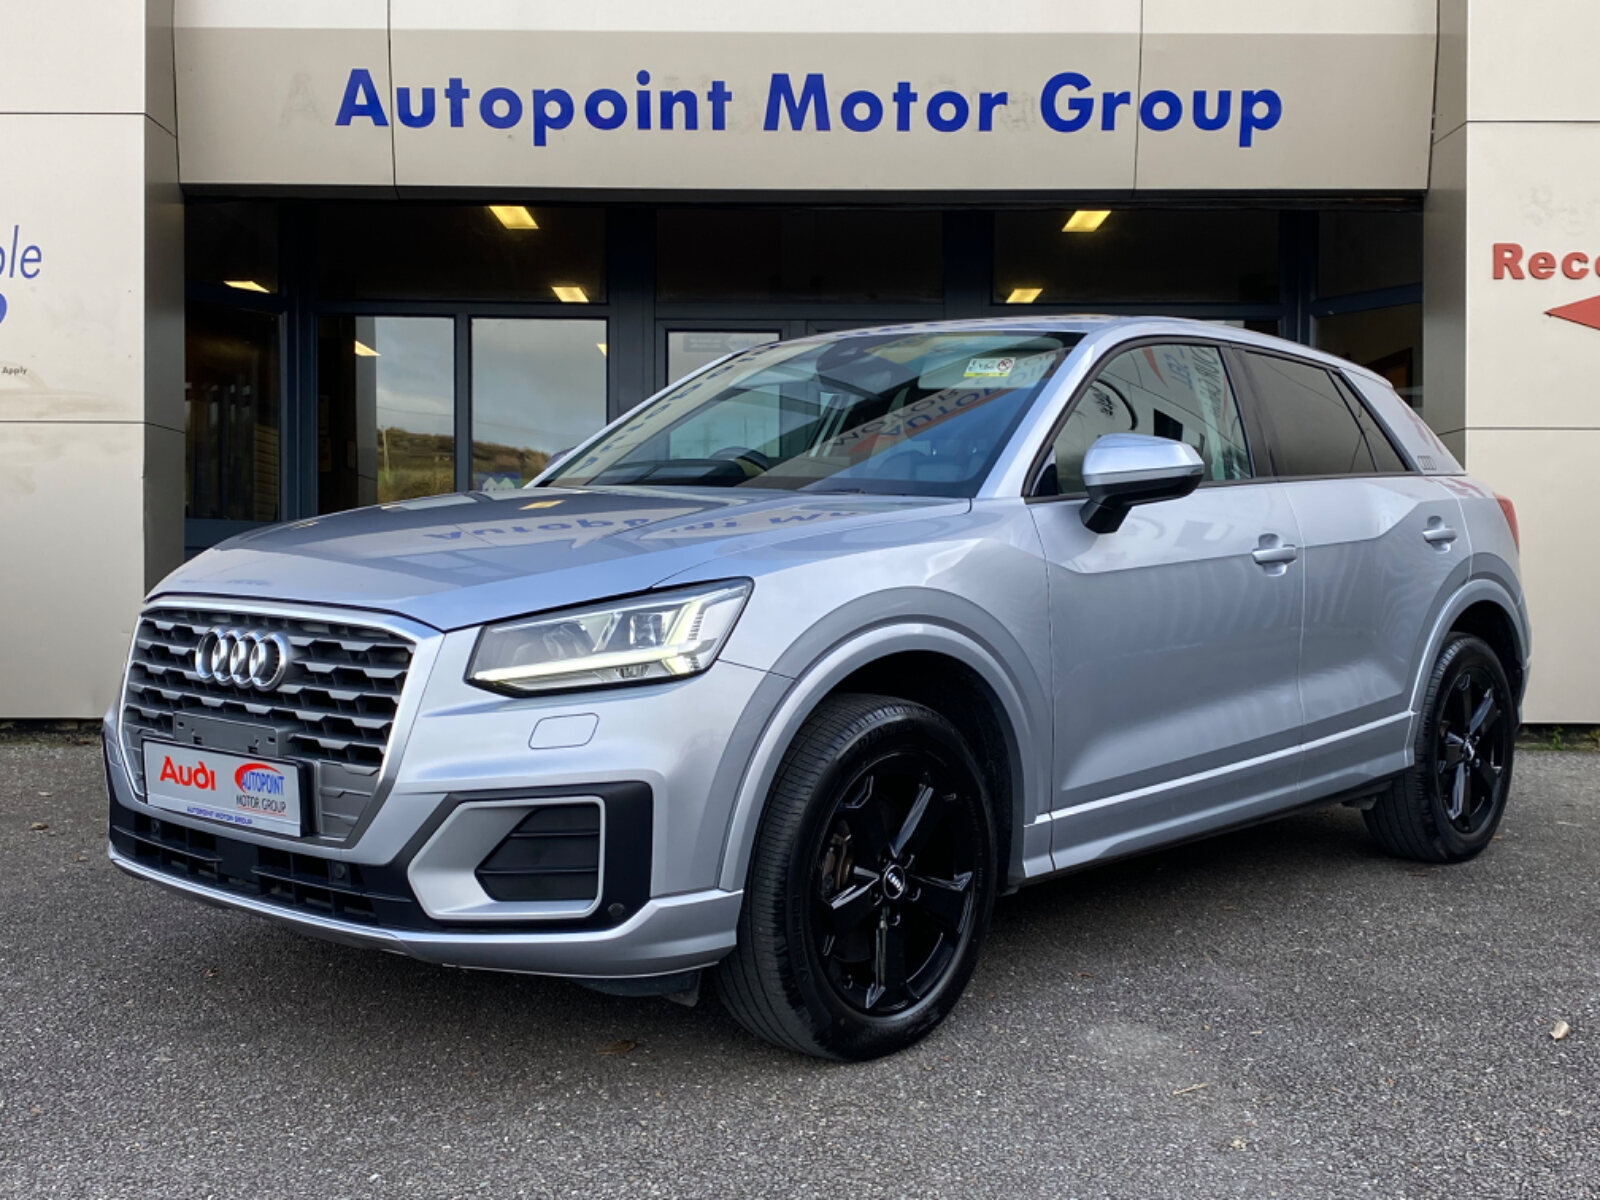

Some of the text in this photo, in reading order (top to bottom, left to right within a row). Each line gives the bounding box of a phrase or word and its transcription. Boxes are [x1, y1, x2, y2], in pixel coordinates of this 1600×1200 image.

[336, 69, 1281, 147] Autopoint Motor Group
[0, 225, 42, 279] le
[1493, 243, 1600, 280] Rec
[1, 365, 28, 376] Apply
[160, 756, 215, 790] Audi
[241, 771, 285, 795] AUTOPOINT
[236, 794, 286, 813] MOTOR GROUP
